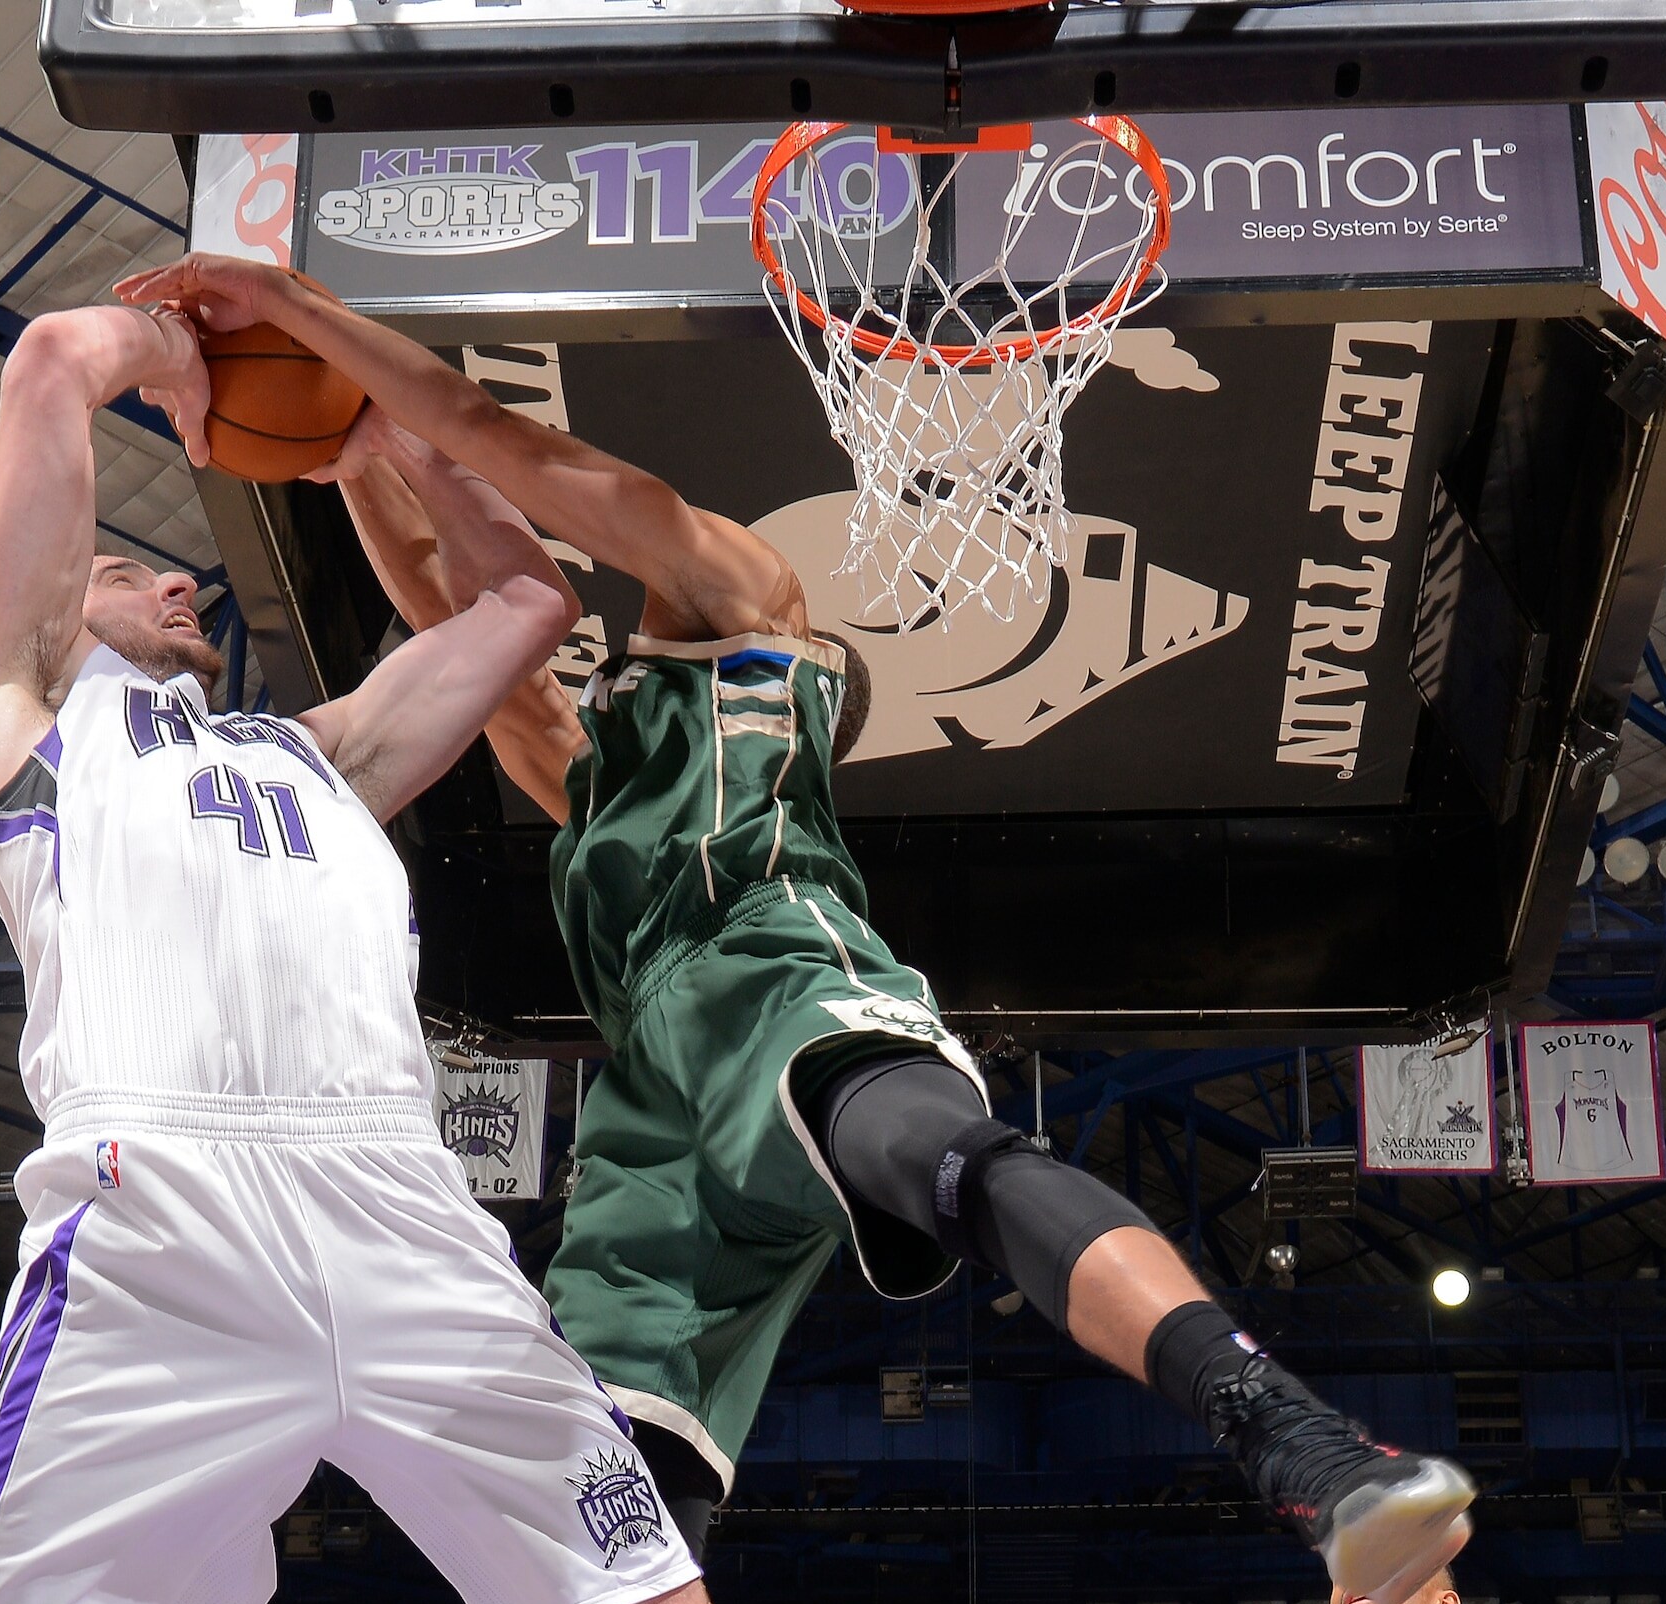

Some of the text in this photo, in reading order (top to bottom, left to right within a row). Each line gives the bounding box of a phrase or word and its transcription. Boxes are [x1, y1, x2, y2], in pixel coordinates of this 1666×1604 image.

[361, 135, 918, 245] KHTK 1140
[315, 181, 584, 237] SPORTS
[374, 227, 521, 239] SACRAMENTO
[838, 213, 880, 236] AM
[1242, 220, 1306, 242] Sleep
[1312, 217, 1397, 241] System
[1403, 216, 1432, 240] by
[1309, 320, 1432, 543] LEEP
[188, 763, 318, 862] 41
[1540, 1032, 1635, 1056] BOLTON
[1586, 1107, 1598, 1123] 6
[443, 1112, 516, 1149] KINGS
[1380, 1136, 1476, 1150] SACRAMENTO
[1389, 1148, 1468, 1161] MONARCHS
[583, 1482, 658, 1544] KINGS
